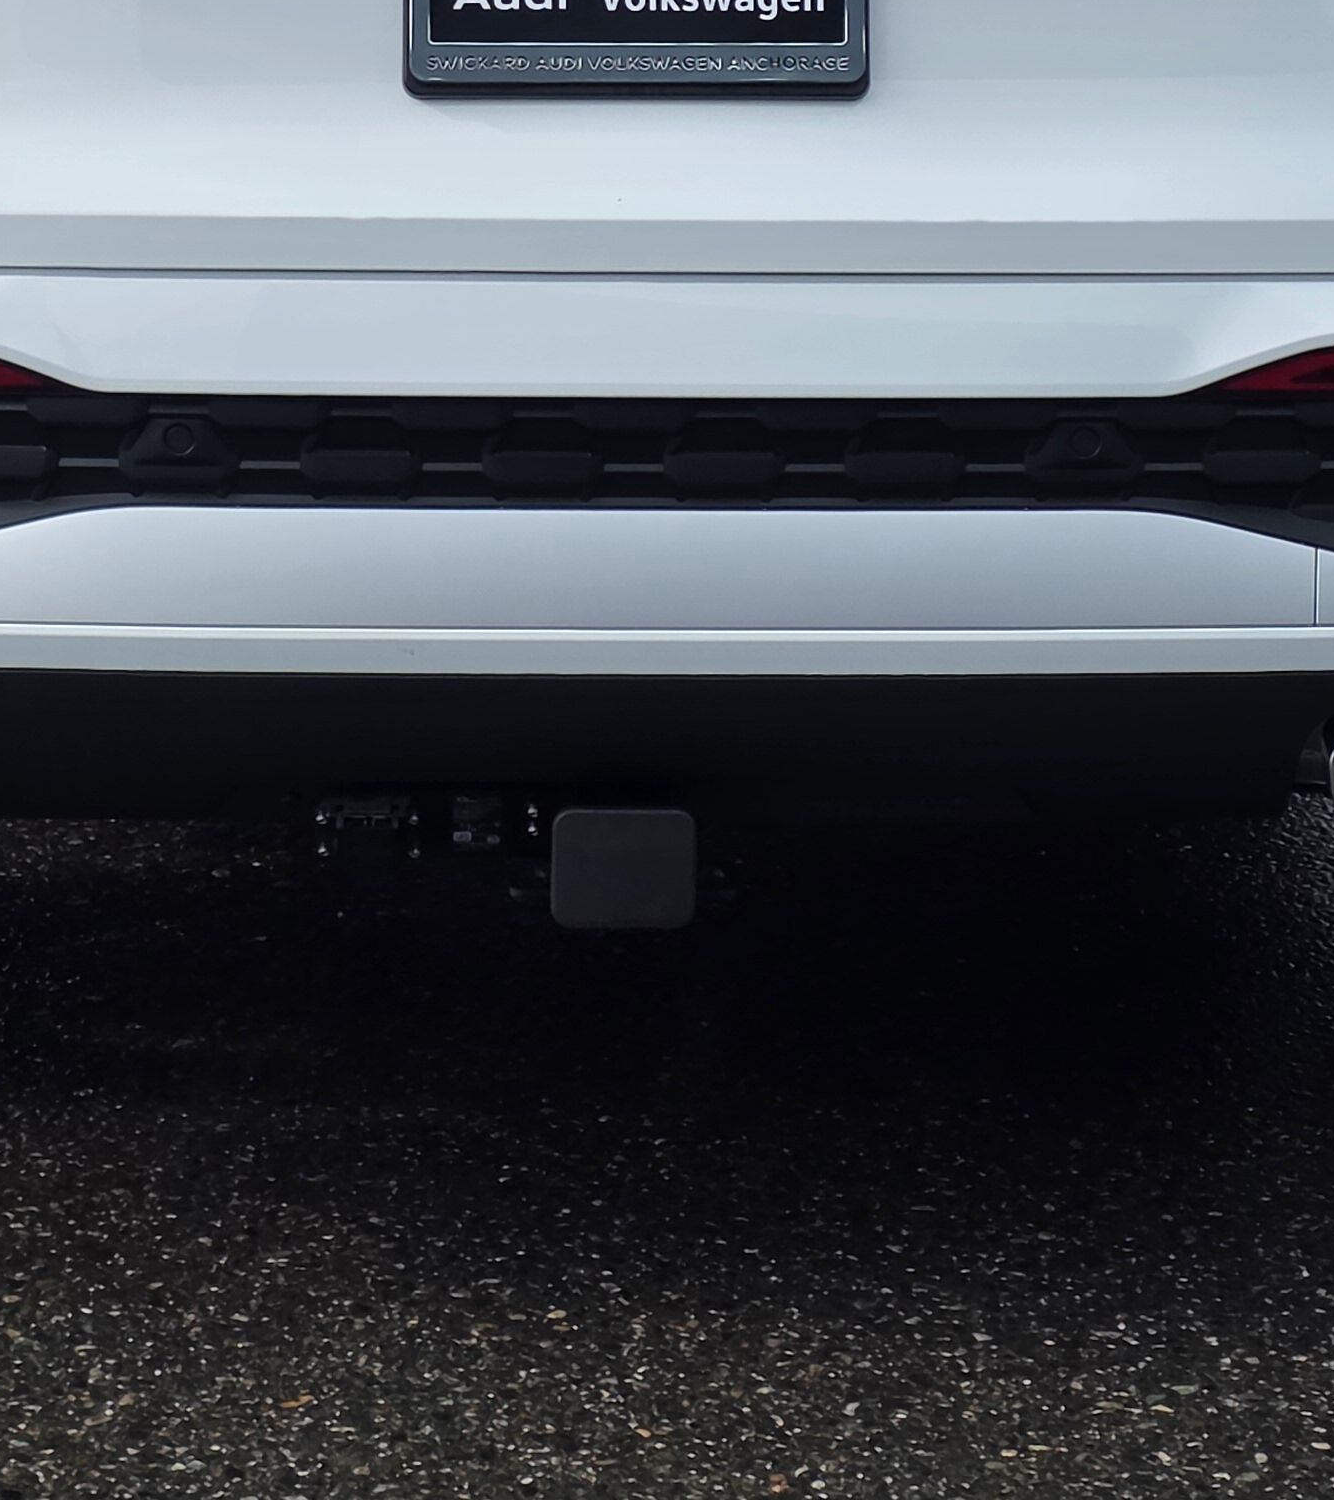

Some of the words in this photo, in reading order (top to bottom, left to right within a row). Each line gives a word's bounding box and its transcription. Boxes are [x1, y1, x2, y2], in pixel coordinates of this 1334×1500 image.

[426, 55, 530, 71] SWICKARD
[534, 55, 583, 71] AUDI
[587, 55, 722, 71] VOLKSWAGEN
[726, 55, 850, 71] ANCHORAGE
